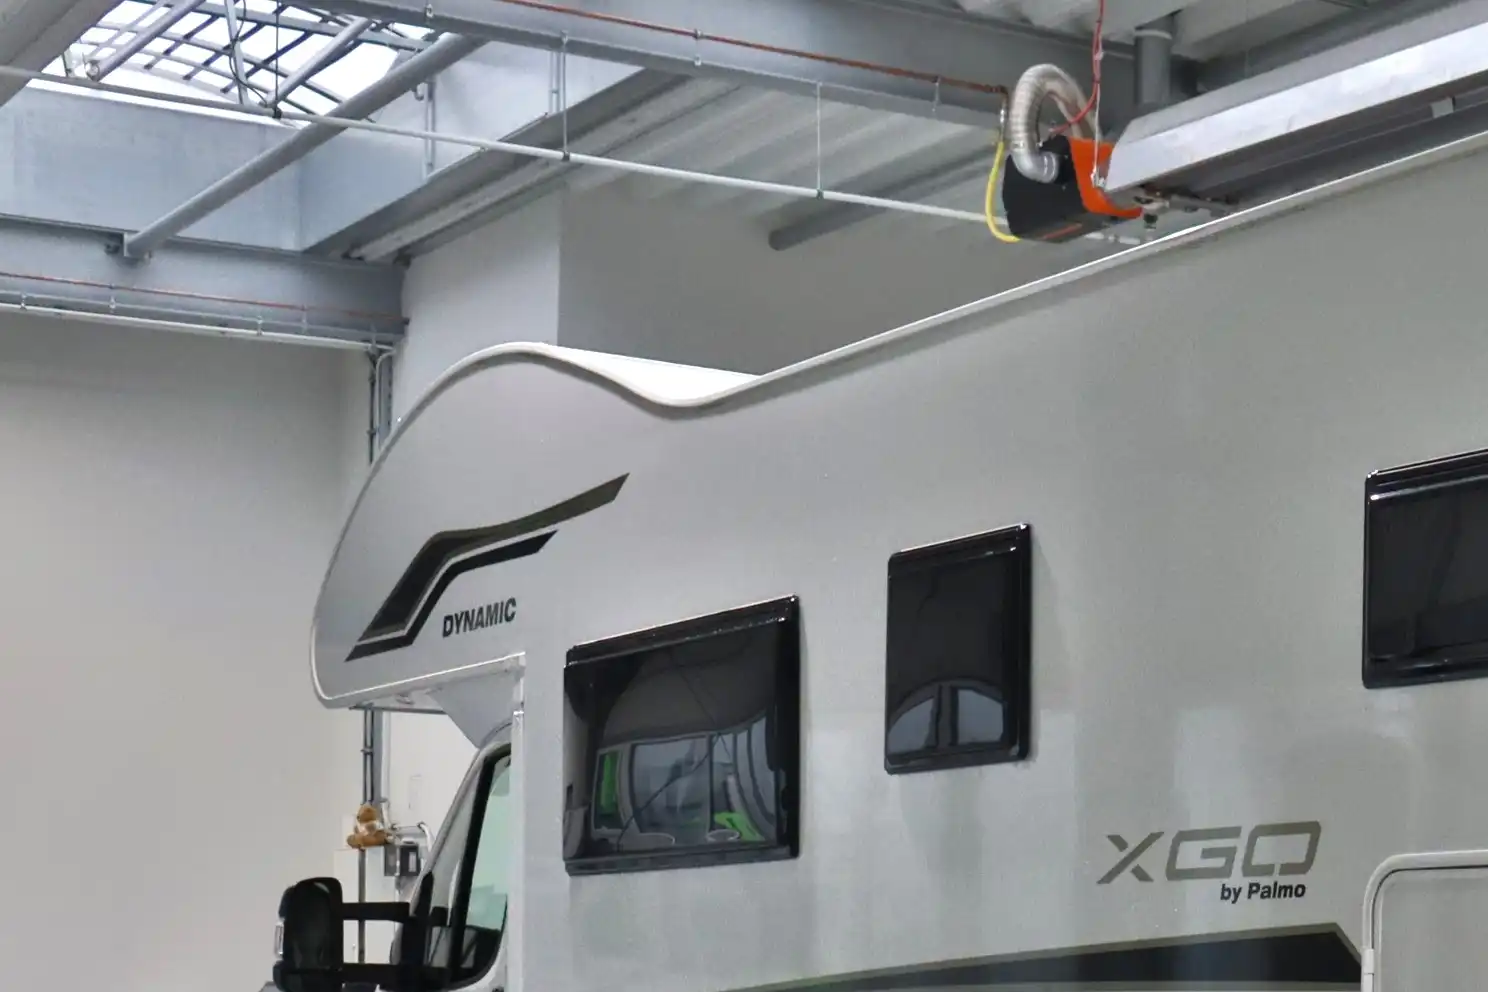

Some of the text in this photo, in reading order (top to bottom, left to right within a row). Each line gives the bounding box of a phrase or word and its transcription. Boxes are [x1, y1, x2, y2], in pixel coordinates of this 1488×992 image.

[442, 596, 517, 638] DYNAMIC
[1096, 820, 1322, 885] XGO
[1220, 880, 1306, 904] by Palmo
